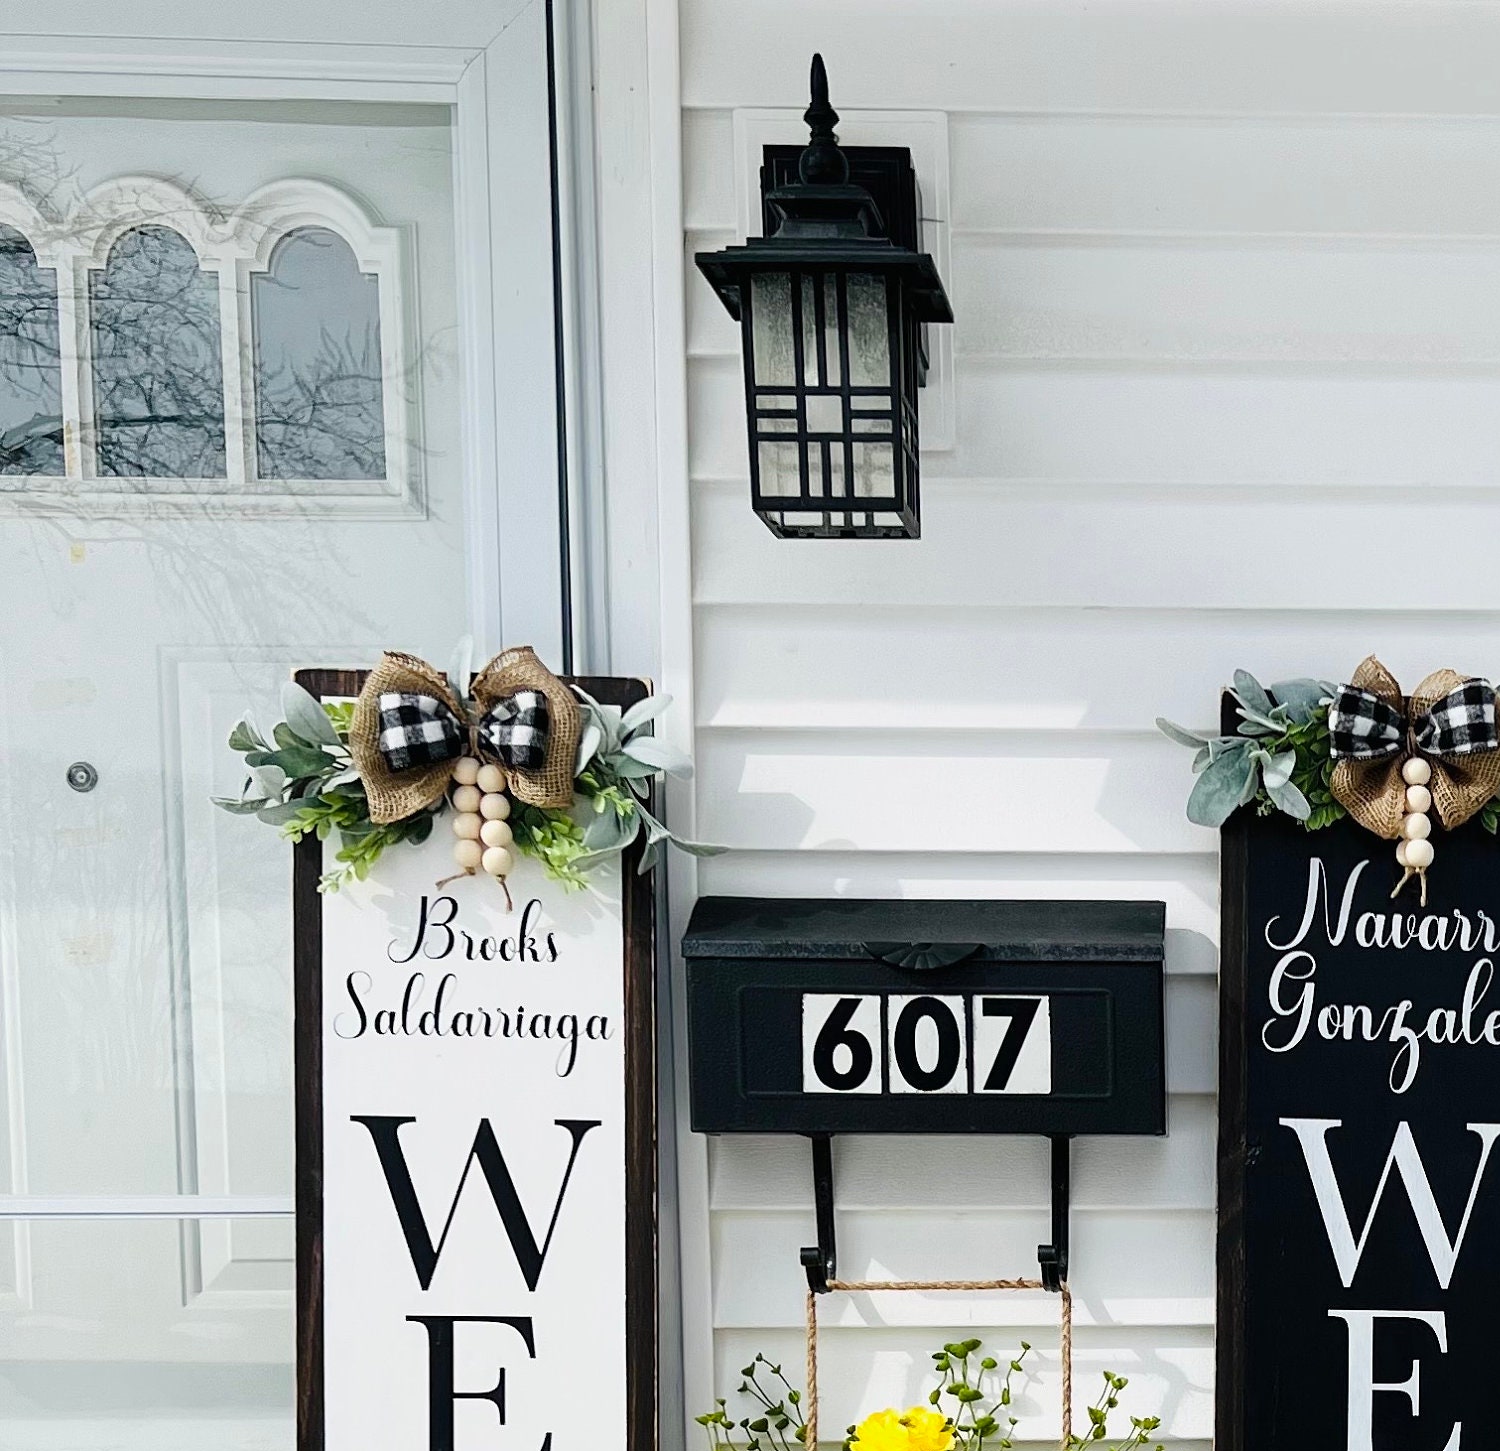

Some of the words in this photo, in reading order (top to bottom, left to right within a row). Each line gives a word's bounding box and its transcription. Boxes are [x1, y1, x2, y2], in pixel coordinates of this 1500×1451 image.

[387, 896, 562, 963] Brooks
[334, 971, 615, 1077] Saldarriaga
[813, 997, 1041, 1091] 607
